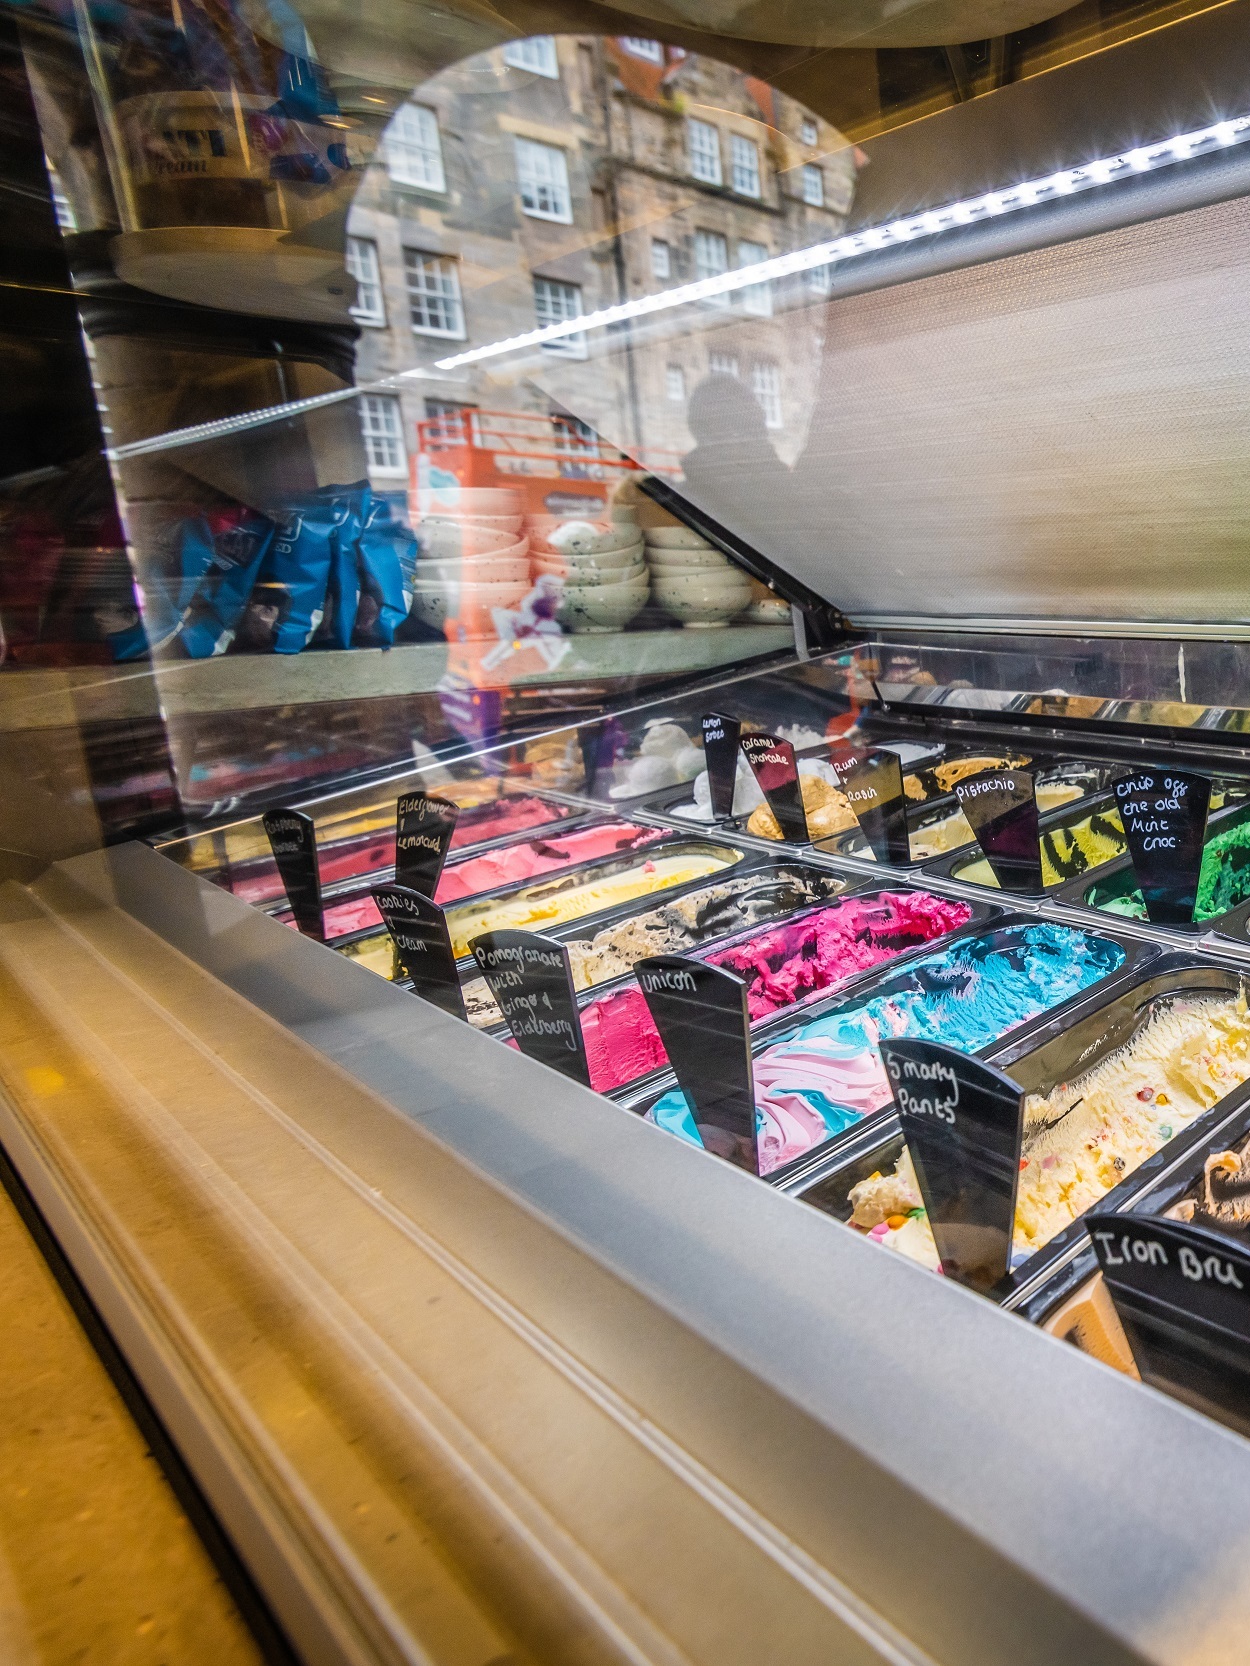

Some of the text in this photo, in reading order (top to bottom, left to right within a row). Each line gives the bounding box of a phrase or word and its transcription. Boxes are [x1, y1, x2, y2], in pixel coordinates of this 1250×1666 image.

[742, 738, 776, 751] Caramel
[833, 756, 858, 773] Rum
[956, 777, 1016, 803] Pistachio
[1116, 775, 1154, 797] Chip
[1123, 801, 1149, 816] the
[1130, 815, 1169, 833] Mint
[376, 894, 420, 916] Cookies
[886, 1052, 959, 1107] Smarty
[897, 1087, 956, 1124] Pants
[1094, 1232, 1244, 1290] Iron Bru
